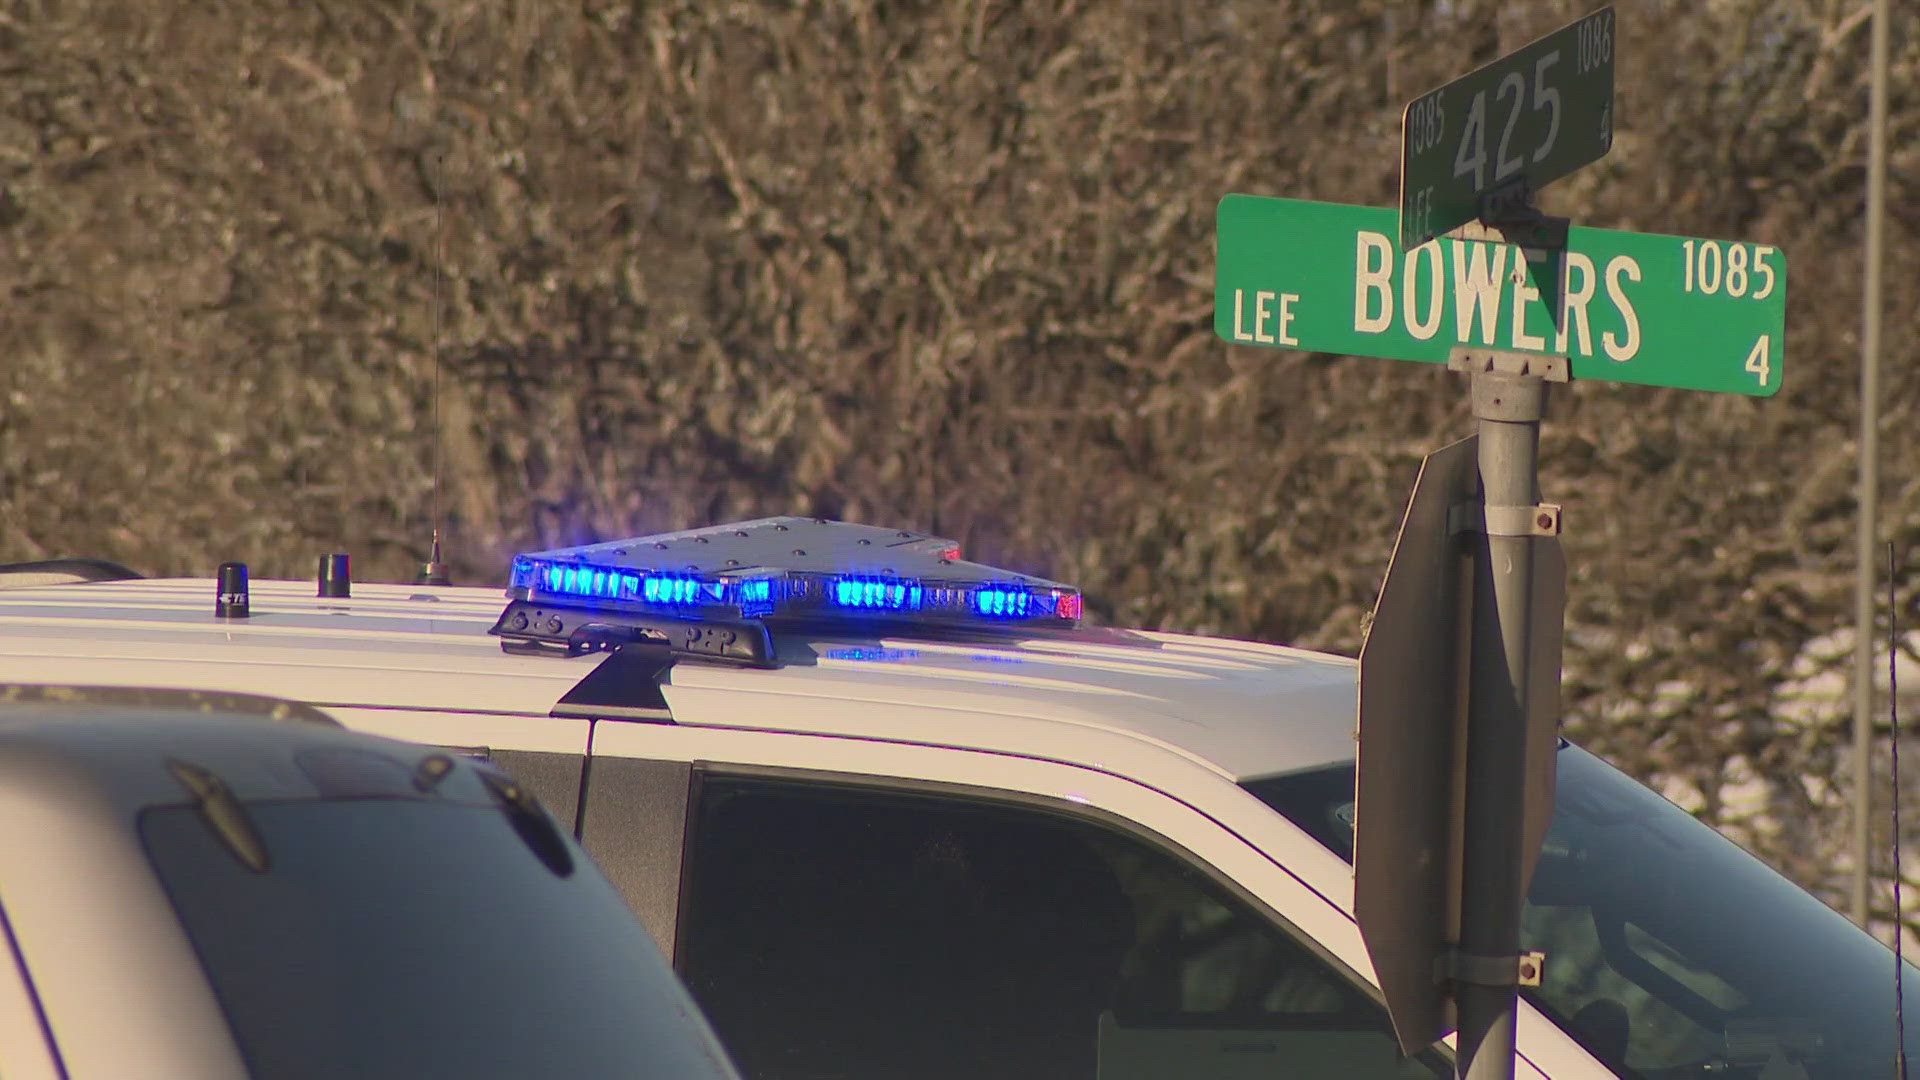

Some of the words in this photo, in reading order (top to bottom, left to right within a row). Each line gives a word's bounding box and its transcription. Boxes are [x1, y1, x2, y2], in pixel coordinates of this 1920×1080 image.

[1577, 13, 1611, 74] 1086
[1409, 91, 1445, 158] 1085
[1453, 51, 1561, 192] 425
[1354, 230, 1642, 362] BOWERS
[1683, 239, 1775, 300] 1085
[1234, 288, 1300, 347] LEE
[1745, 334, 1770, 387] 4
